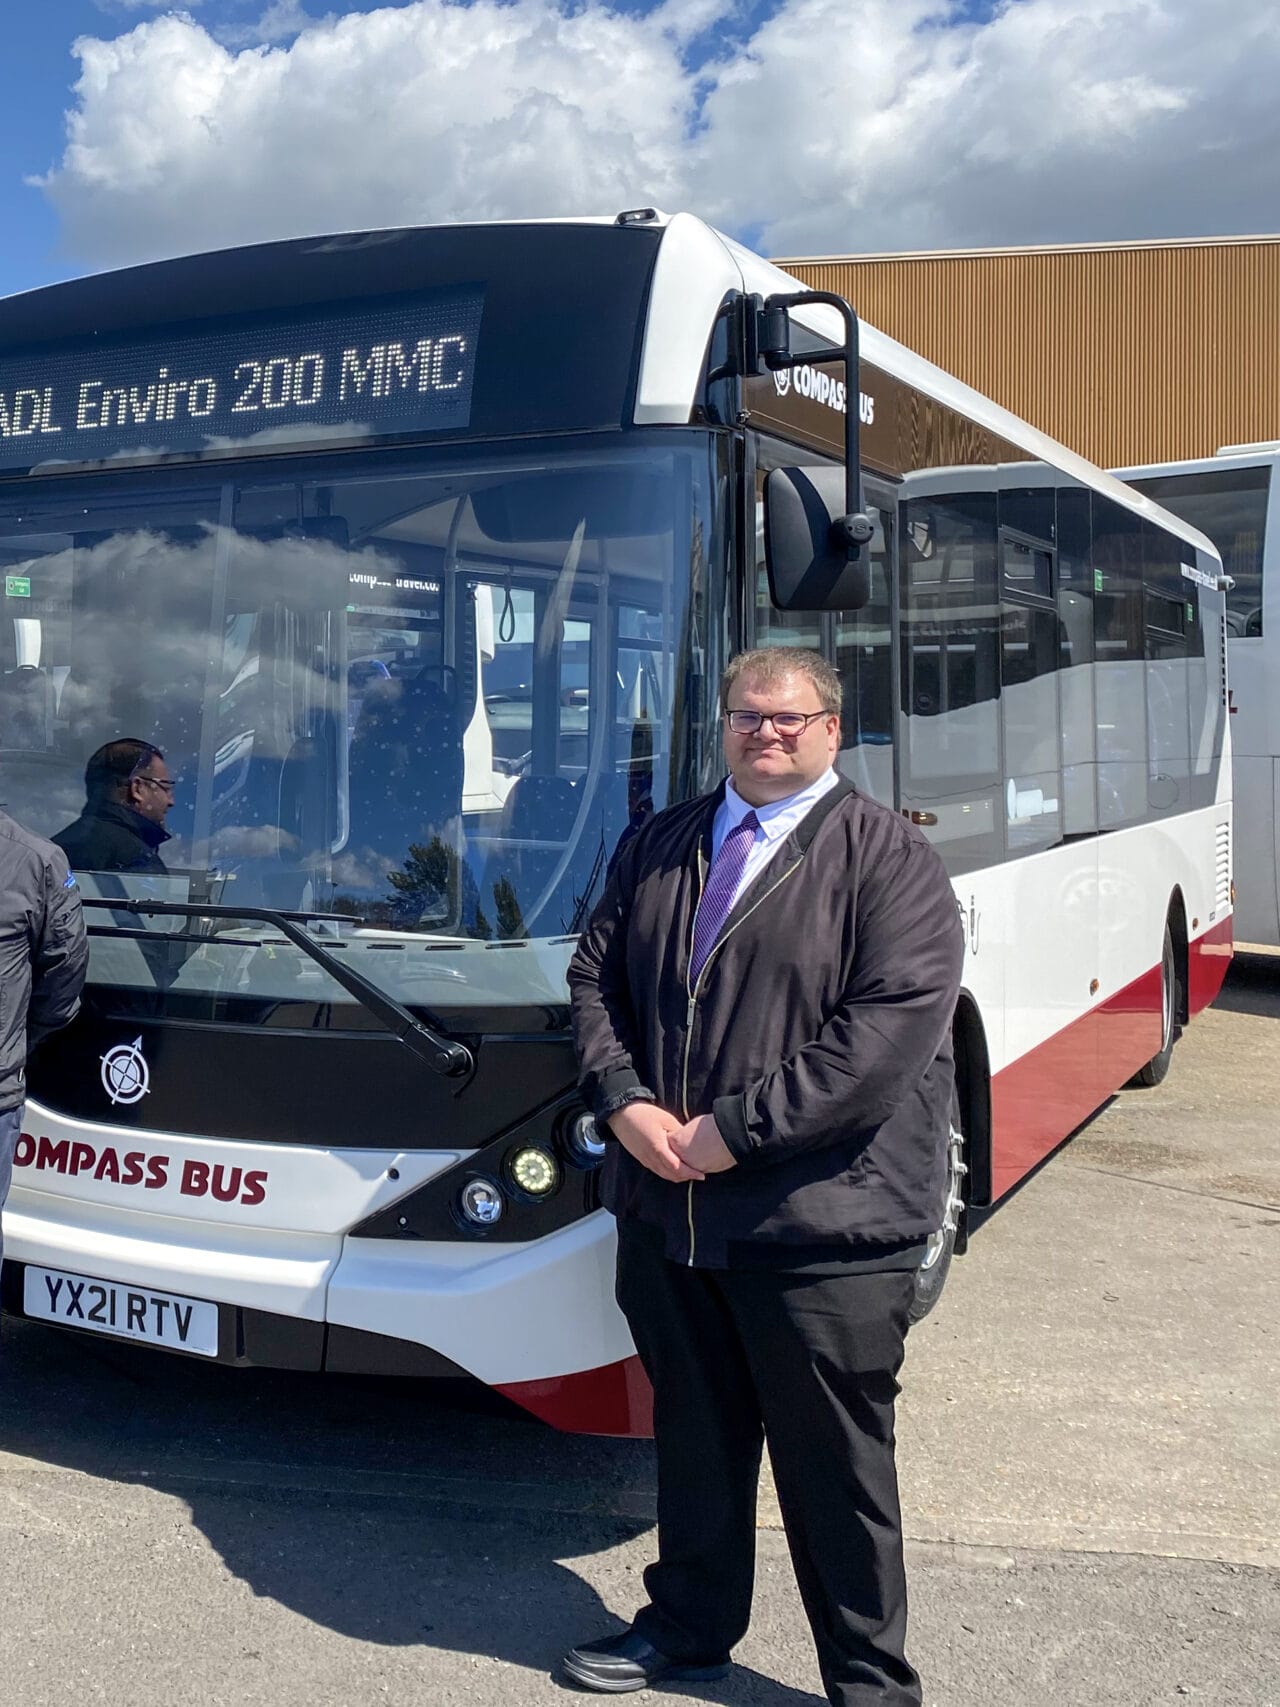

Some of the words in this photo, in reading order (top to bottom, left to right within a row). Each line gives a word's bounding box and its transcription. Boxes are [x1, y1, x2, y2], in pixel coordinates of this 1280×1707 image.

[76, 367, 217, 429] Enviro
[231, 353, 325, 413] 200
[339, 335, 466, 401] MMC
[793, 364, 847, 414] COMPAS
[858, 391, 875, 425] US
[13, 1132, 170, 1190] OMPASS
[180, 1159, 269, 1206] BUS
[45, 1275, 116, 1326] YX21
[127, 1292, 193, 1342] RTV
